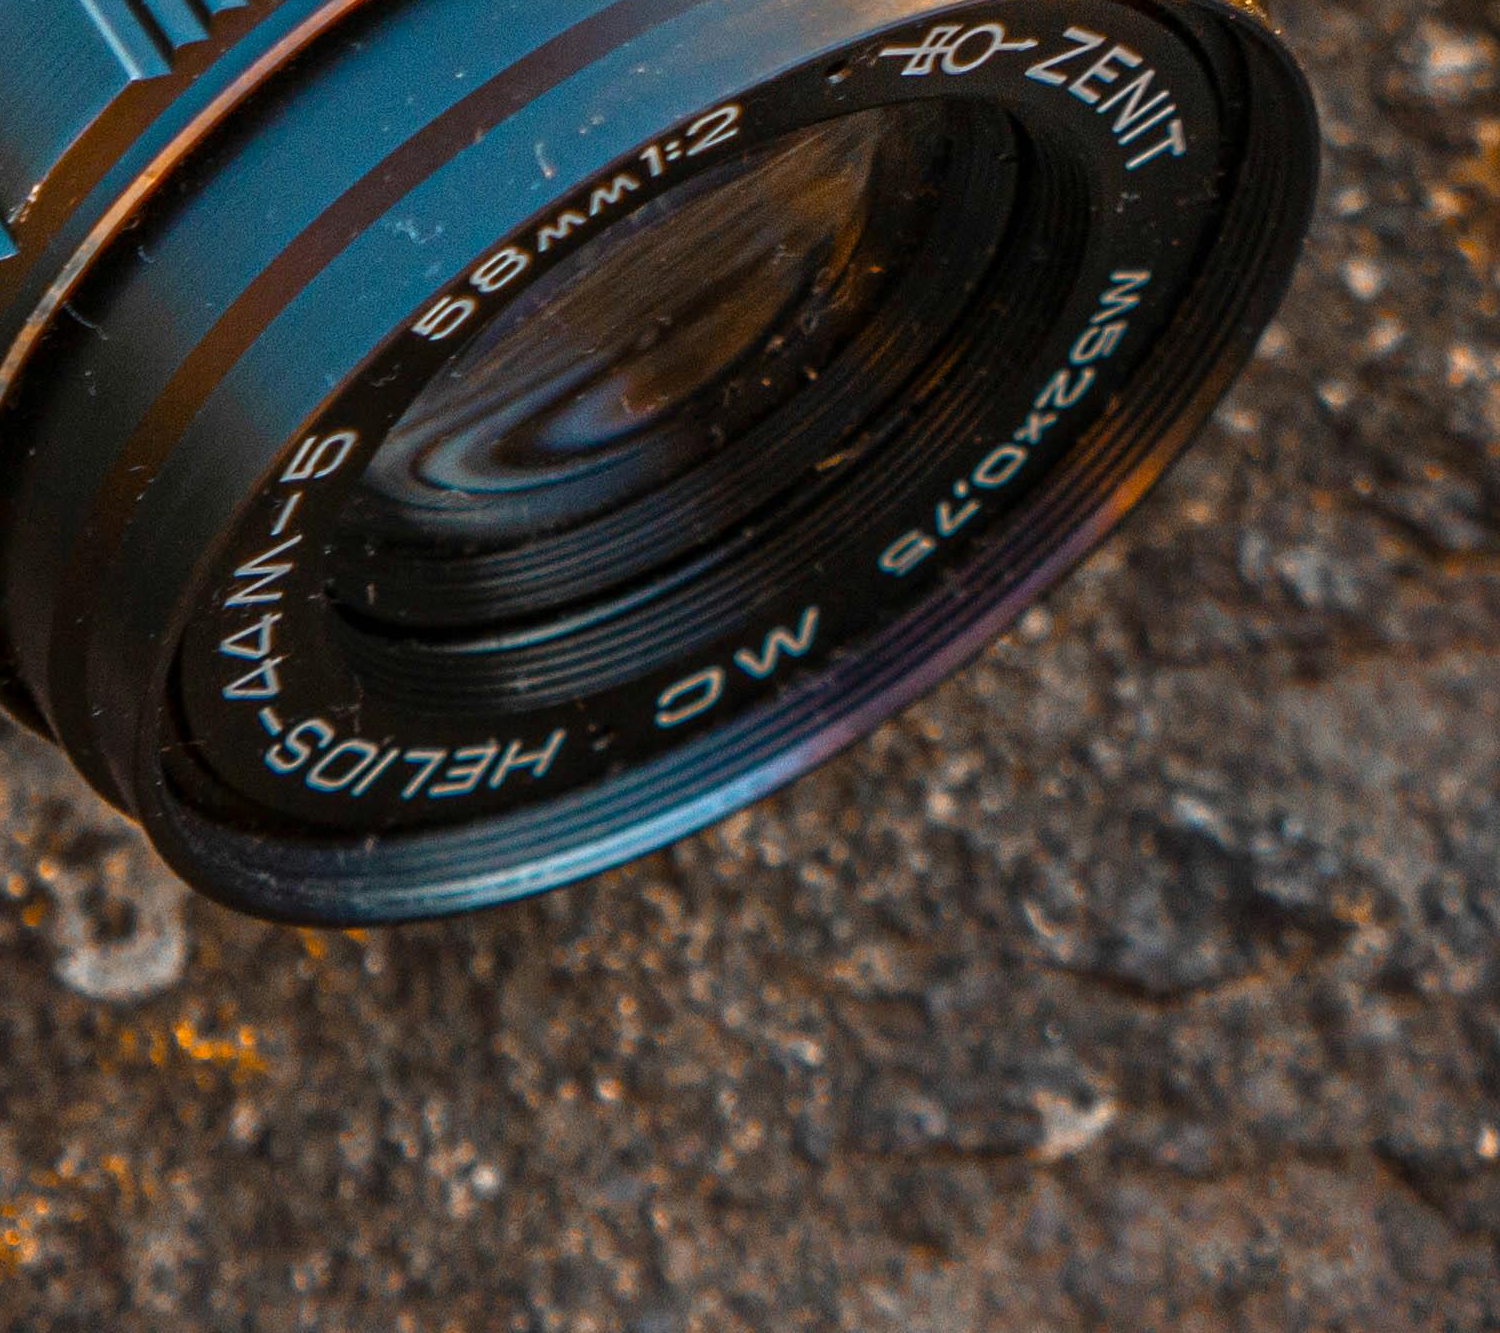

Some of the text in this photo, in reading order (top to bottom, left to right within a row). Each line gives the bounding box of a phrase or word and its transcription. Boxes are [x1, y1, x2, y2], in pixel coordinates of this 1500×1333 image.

[1024, 25, 1187, 170] ZENIT
[218, 431, 567, 799] HELIOS-44M-5
[655, 605, 820, 730] MC
